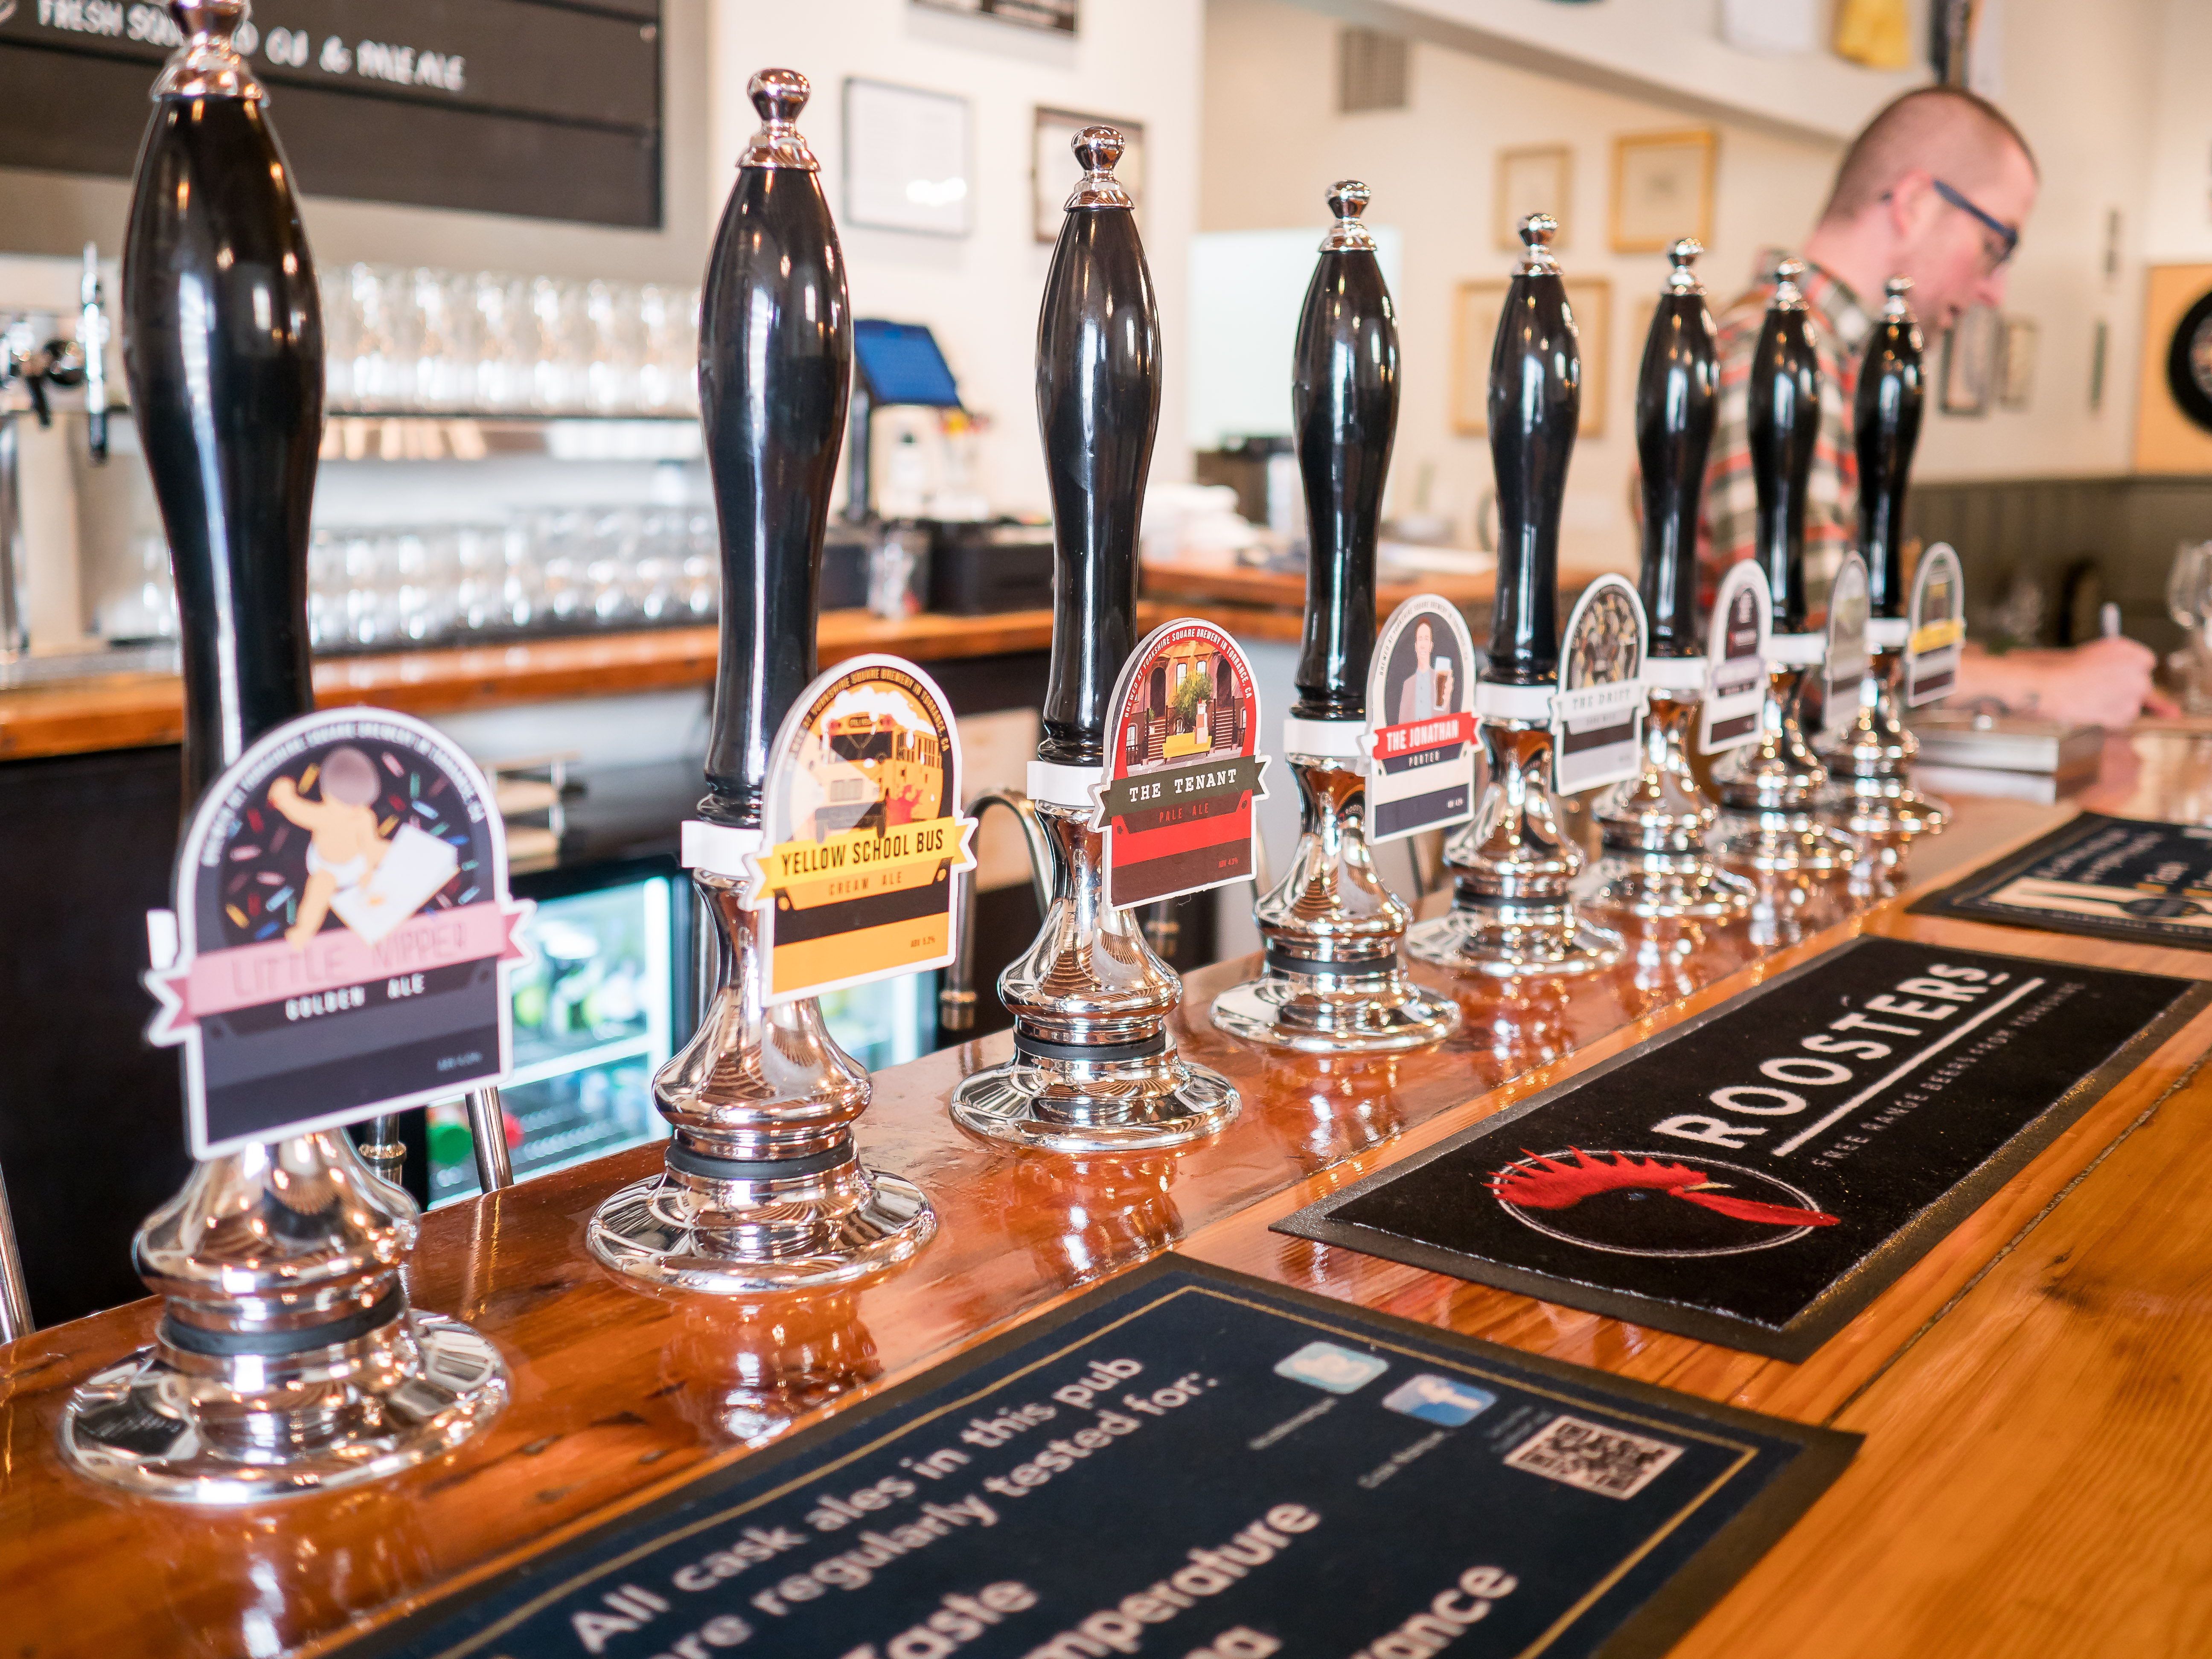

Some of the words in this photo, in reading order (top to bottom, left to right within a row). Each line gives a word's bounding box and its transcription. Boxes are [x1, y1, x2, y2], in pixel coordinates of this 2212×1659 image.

[1124, 682, 1138, 718] BREWED
[1137, 672, 1144, 682] AT
[1143, 635, 1170, 669] YORKSHIRE
[1172, 629, 1195, 642] SQUARE
[1196, 629, 1221, 645] BREWERY
[1220, 640, 1228, 651] IN
[1226, 646, 1249, 687] TORRANCE,
[1244, 687, 1252, 699] CA
[1573, 695, 1593, 710] THE
[940, 737, 950, 752] CA
[1386, 729, 1406, 752] THE
[1409, 719, 1459, 748] JONATHAN
[1409, 751, 1440, 767] PORTER
[1129, 783, 1161, 803] THE
[1174, 768, 1237, 794] TENANT
[1159, 808, 1183, 823] PALE
[1192, 803, 1209, 816] ALE
[781, 844, 847, 876] YELLOW
[853, 834, 909, 864] SCHOOL
[917, 829, 943, 853] BUS
[829, 877, 869, 896] CREAM
[882, 871, 902, 886] ALE
[232, 942, 346, 998] LITTLE
[387, 973, 425, 999] ALE
[571, 1583, 670, 1653] All
[672, 1525, 809, 1592] cask
[805, 1475, 916, 1532] ales
[900, 1445, 972, 1479] in
[961, 1400, 1058, 1449] this
[1052, 1355, 1144, 1410] pub
[751, 1493, 999, 1616] regularly
[984, 1408, 1141, 1498] tested
